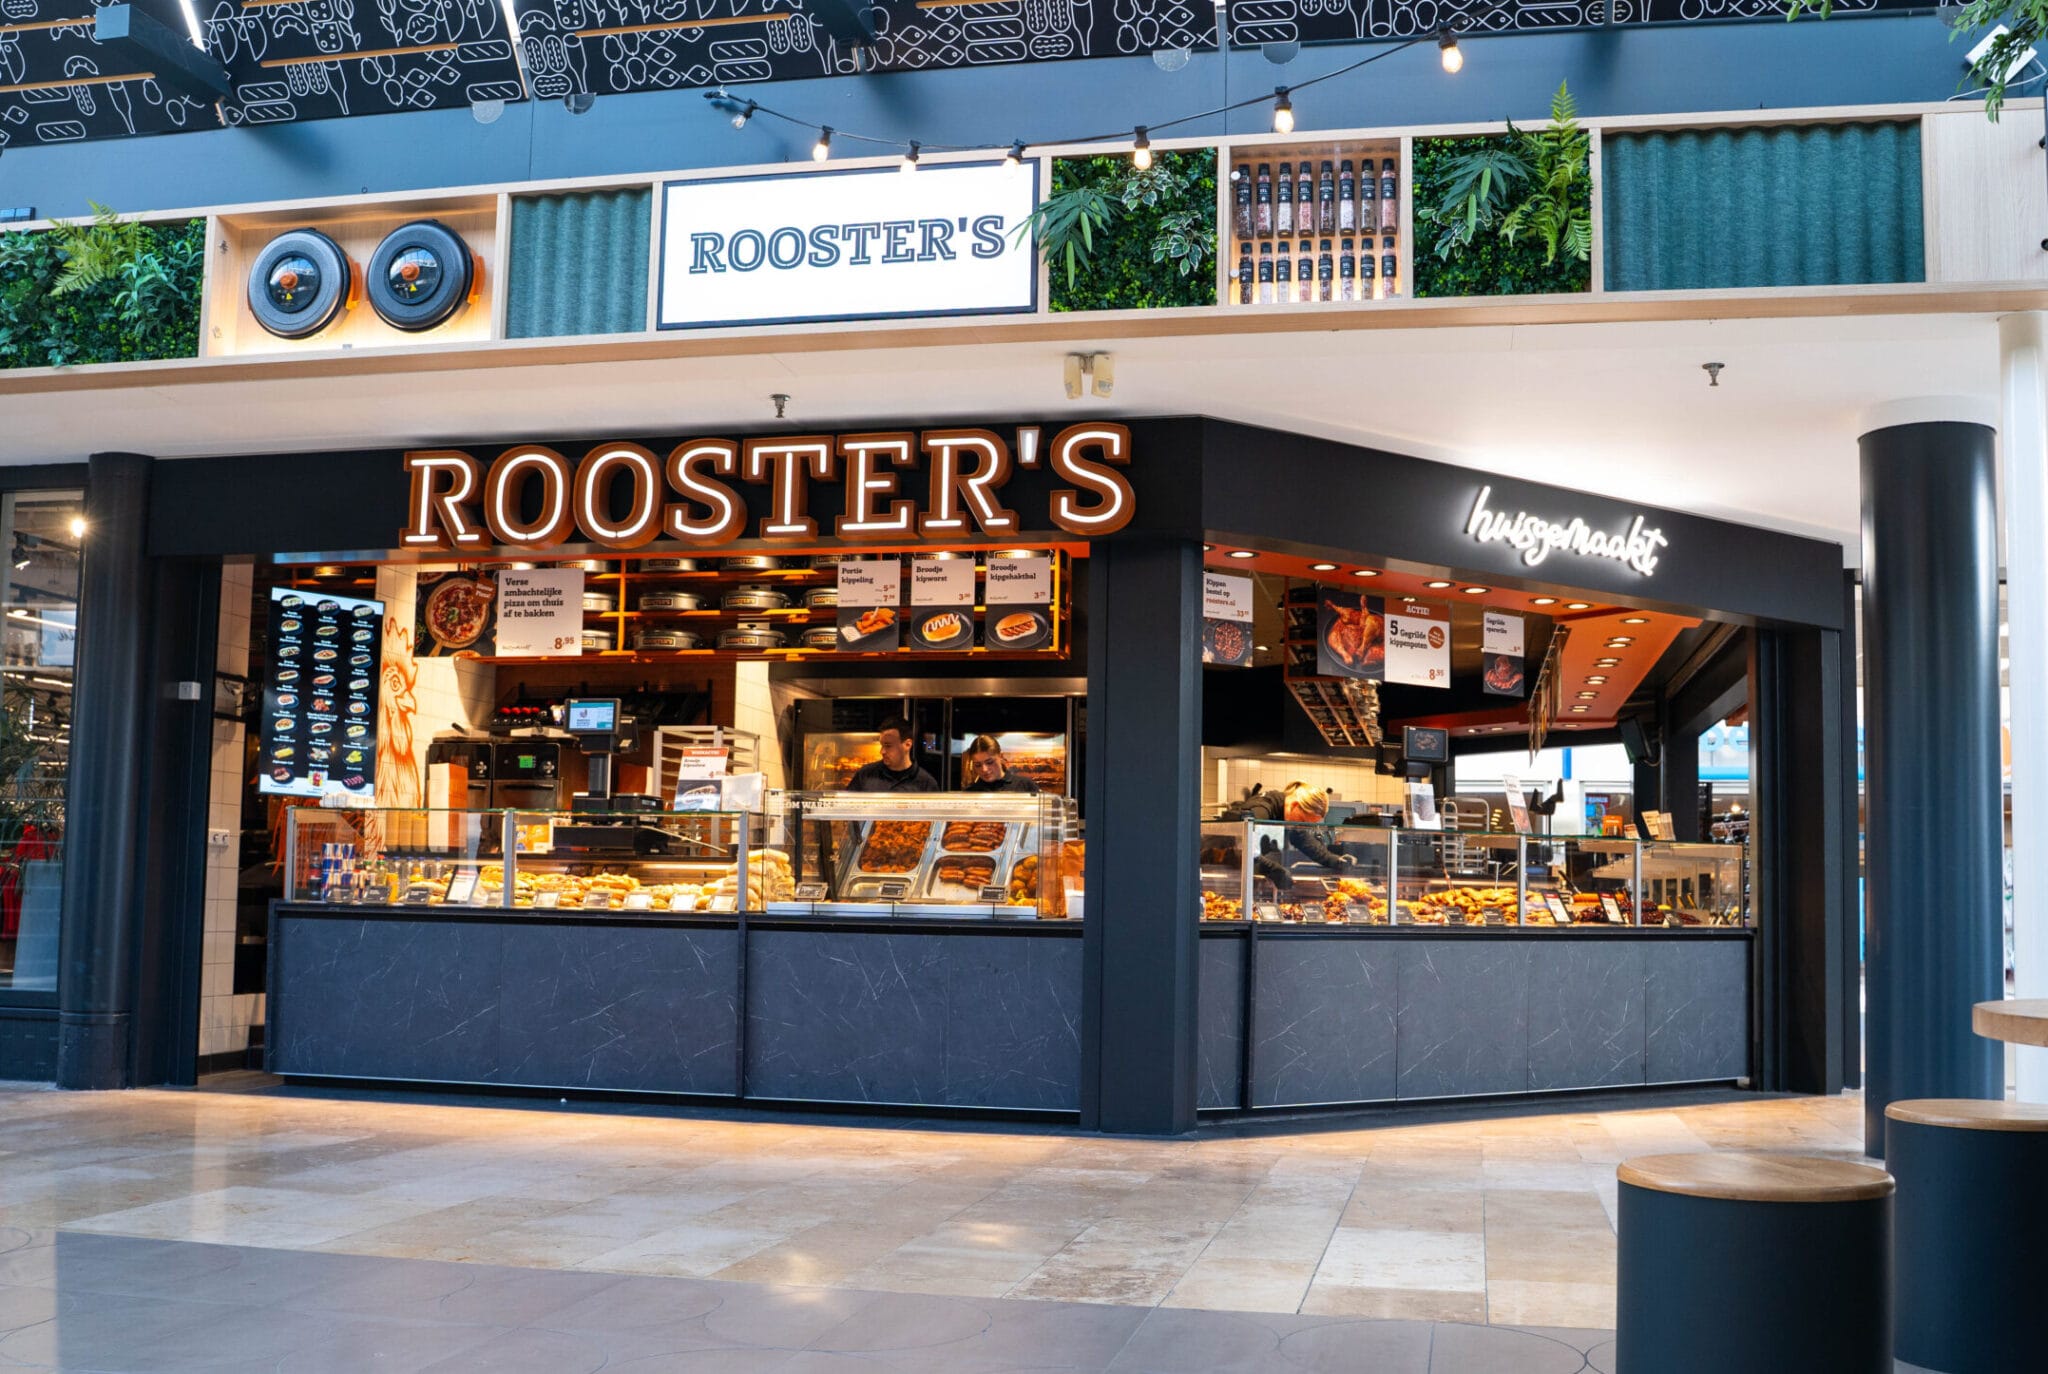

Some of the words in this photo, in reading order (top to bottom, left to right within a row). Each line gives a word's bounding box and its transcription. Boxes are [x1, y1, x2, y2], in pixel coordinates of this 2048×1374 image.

[689, 215, 1006, 274] ROOSTER'S
[400, 422, 1136, 552] ROOSTER'S
[1465, 486, 1669, 577] huisgemaakt
[916, 566, 943, 574] Broodje
[990, 563, 1018, 572] Broodje
[505, 577, 529, 586] Verse
[841, 576, 874, 585] kippeling
[916, 575, 948, 583] kipworst
[504, 587, 563, 598] ambachtelijke
[504, 599, 525, 609] pizza
[542, 598, 564, 607] thuis
[503, 609, 513, 618] af
[514, 610, 522, 618] te
[524, 609, 555, 618] bakken
[1390, 619, 1398, 636] 5
[1400, 629, 1426, 640] Gegrilde
[1389, 637, 1428, 649] kippenpoten
